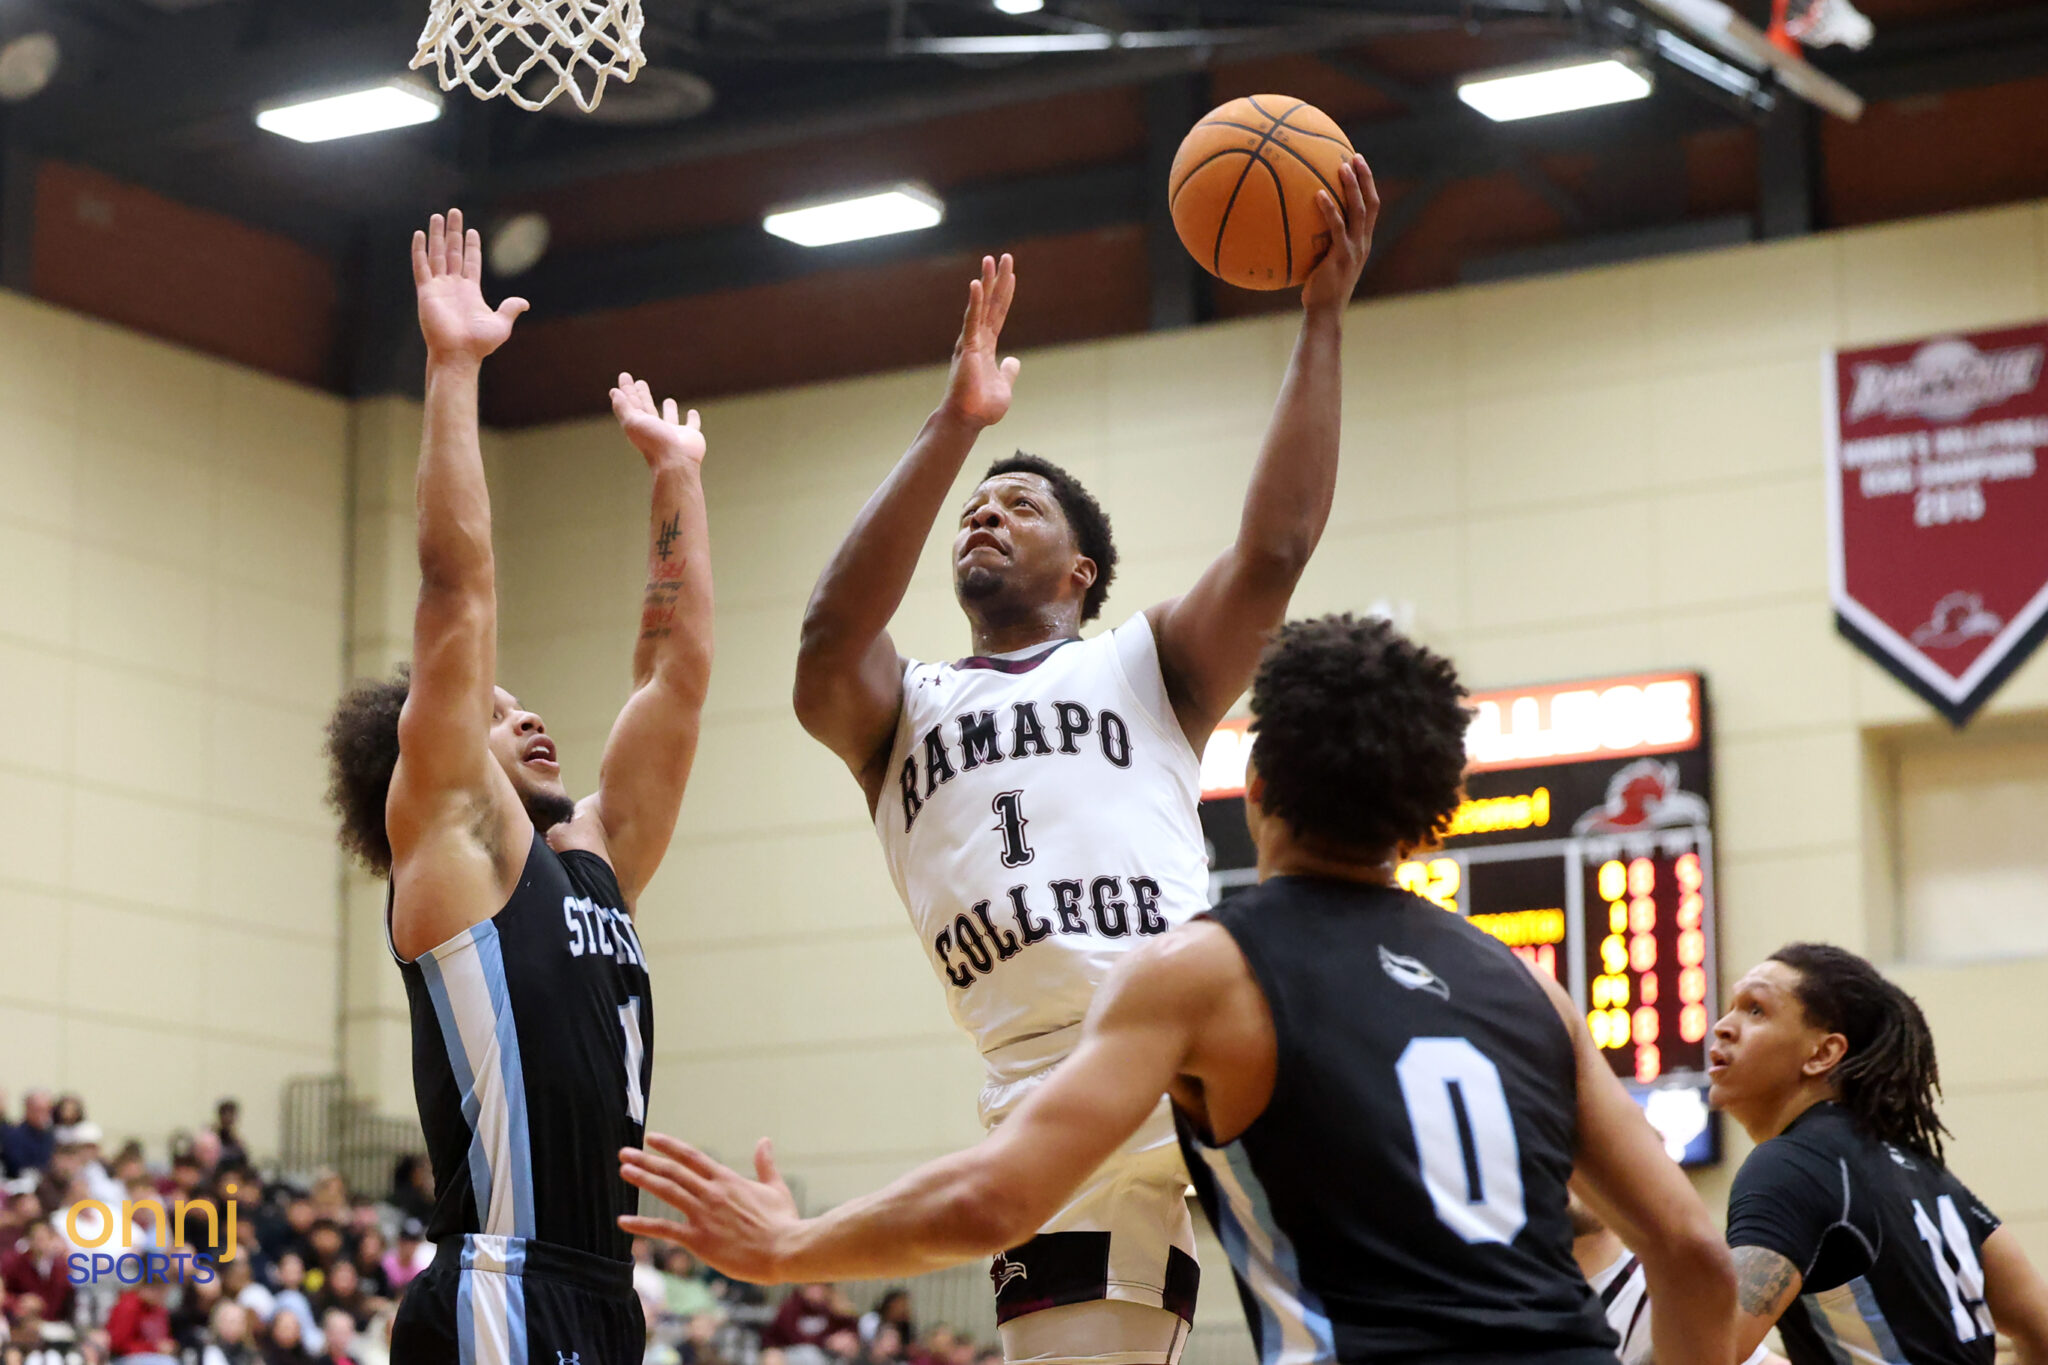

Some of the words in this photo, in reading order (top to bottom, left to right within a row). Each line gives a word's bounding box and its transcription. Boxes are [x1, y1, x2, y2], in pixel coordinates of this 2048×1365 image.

[899, 701, 1134, 834] RAMAPO
[992, 789, 1035, 869] 1
[935, 876, 1169, 989] COLLEGE
[1395, 1037, 1528, 1246] 0
